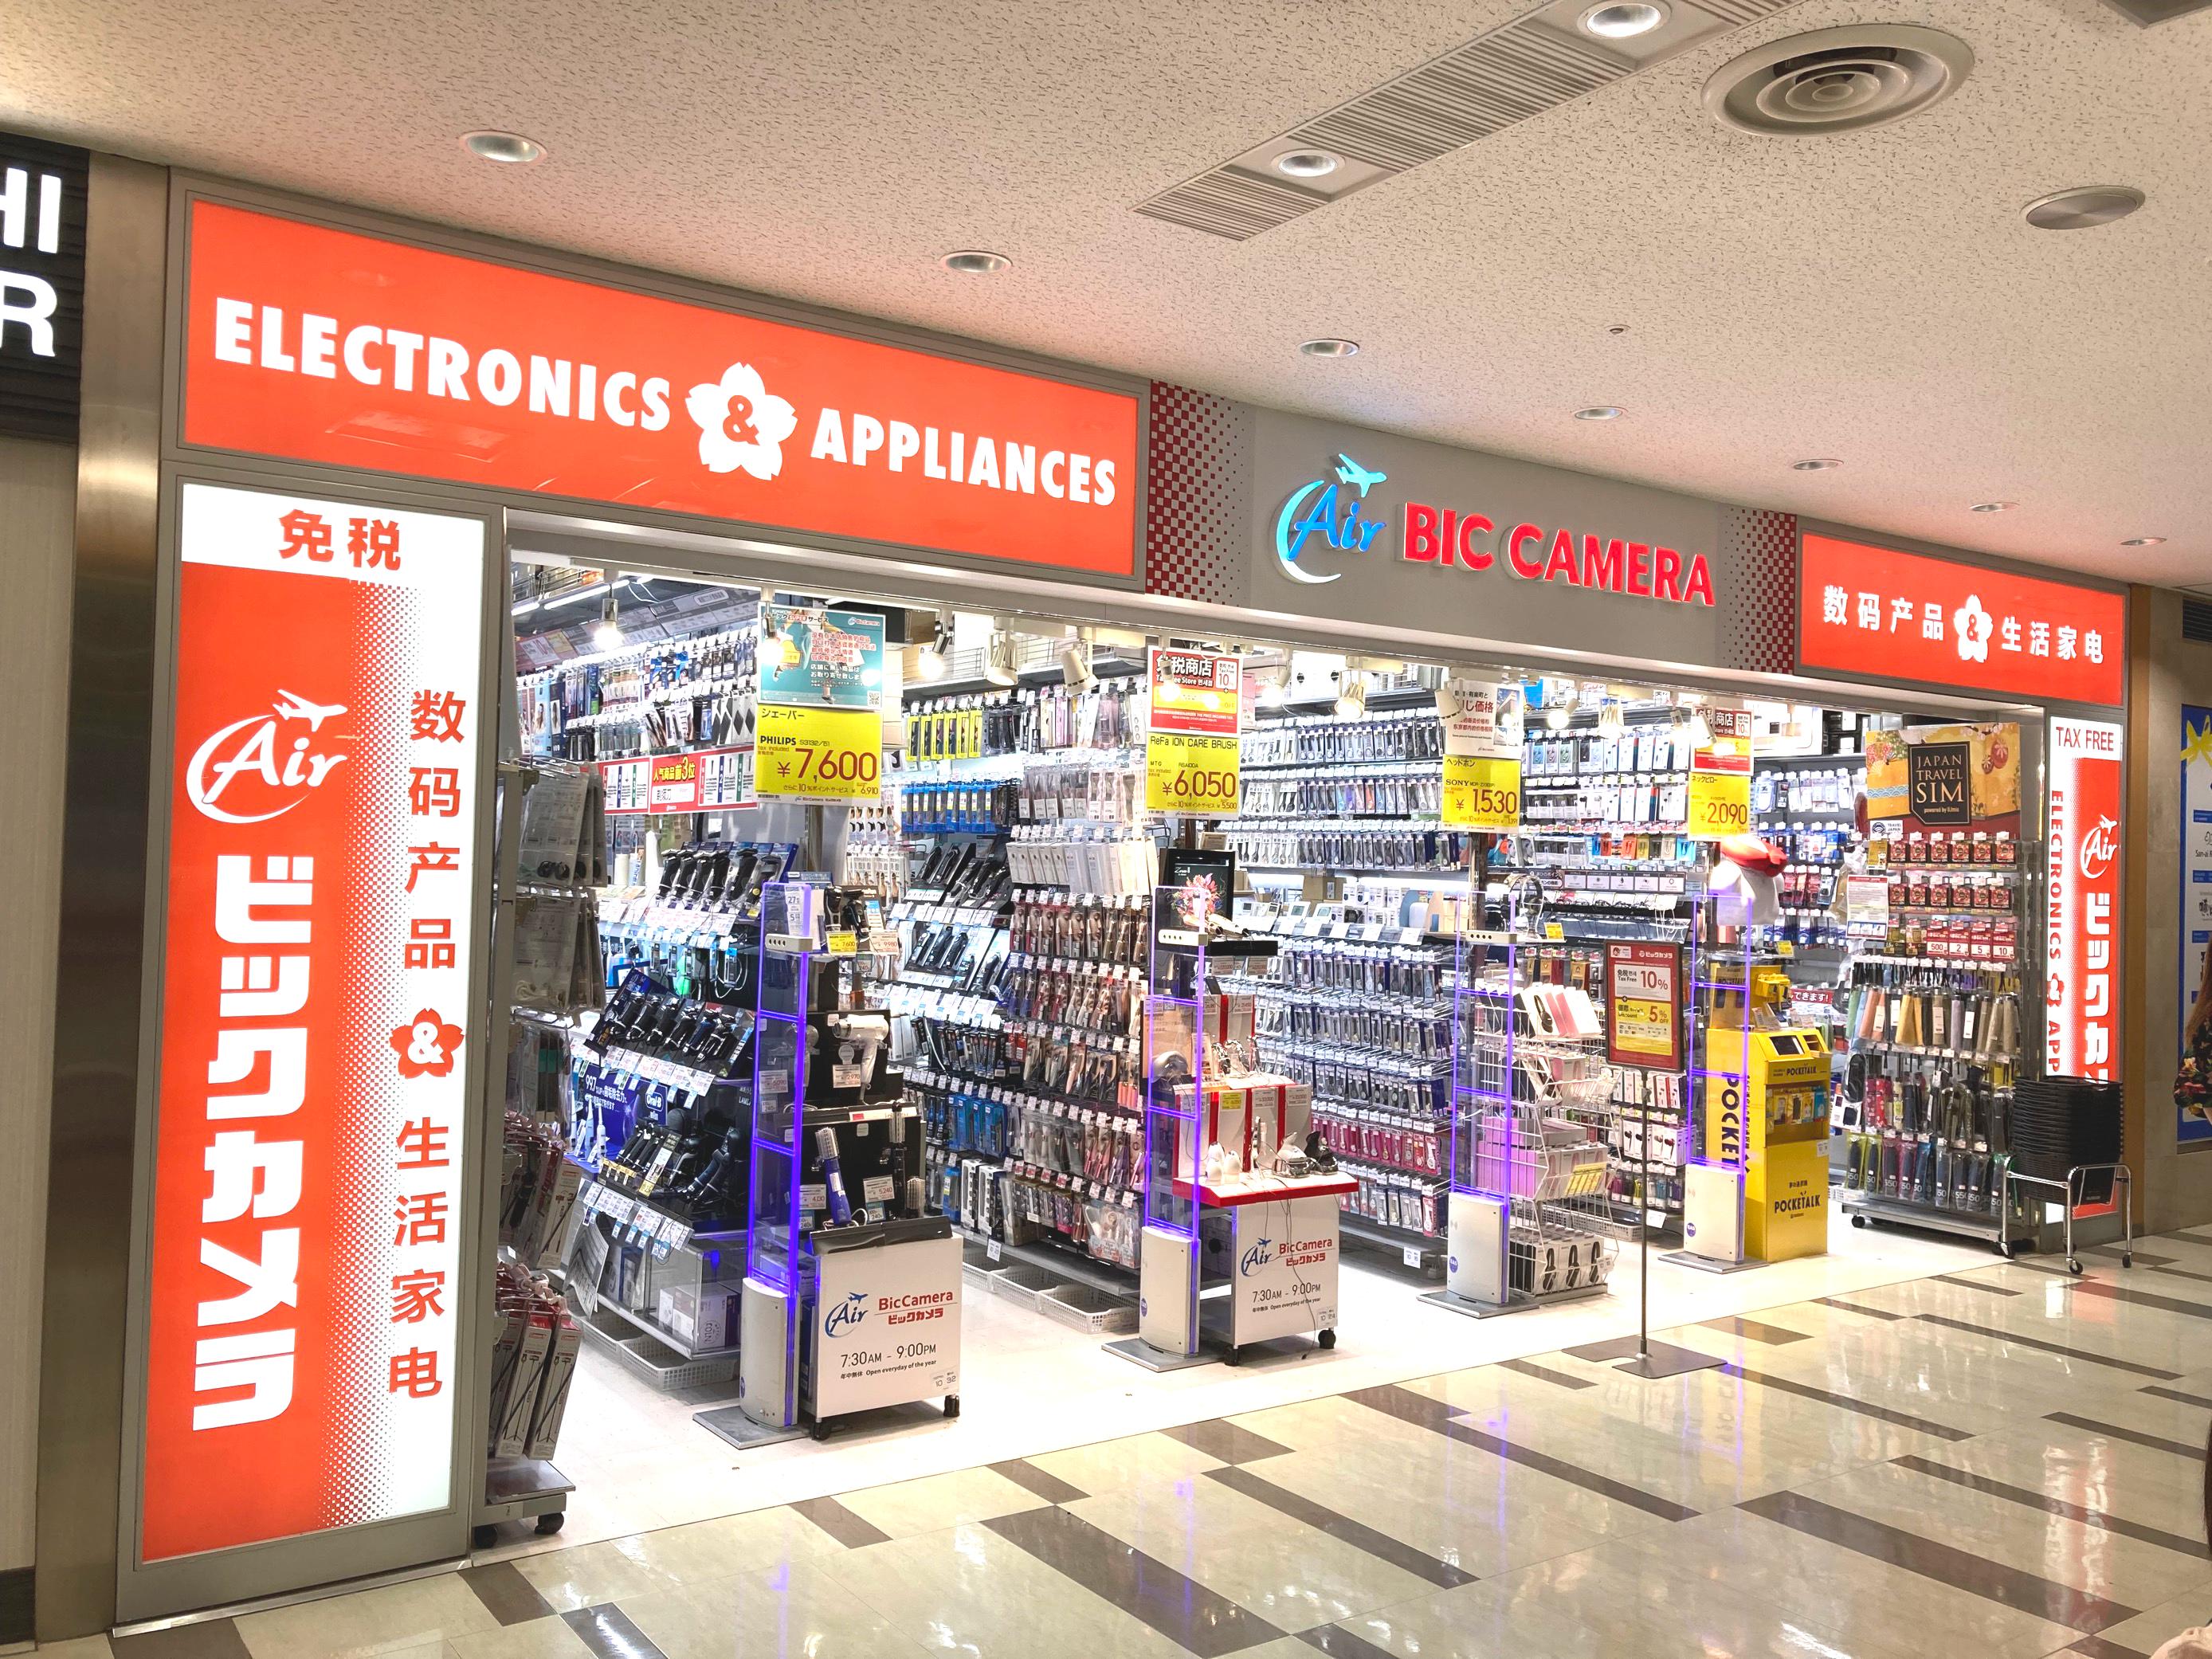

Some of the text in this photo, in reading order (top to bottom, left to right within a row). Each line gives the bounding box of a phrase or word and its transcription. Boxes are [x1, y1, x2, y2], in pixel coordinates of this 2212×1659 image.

[214, 296, 1115, 506] ELECTRONICS & APPLIANCES
[278, 508, 402, 571] 免税
[1288, 483, 1716, 607] Air BIC CAMERA
[1823, 586, 2104, 665] 数码产品 & 生活家电
[810, 671, 861, 680] お取り寄せ致しま
[761, 708, 805, 720] シェーバー
[1462, 699, 1494, 713] じ価格
[760, 735, 796, 746] PHILIPS
[1150, 735, 1237, 749] ReFa ION CARE BRUSH
[2056, 726, 2114, 751] TAX FREE
[202, 720, 348, 805] Air
[1916, 754, 1962, 769] JAPAN
[1916, 768, 1963, 781] TRAVEL
[861, 786, 879, 795] 6,910
[1916, 782, 1964, 804] SIM
[2085, 829, 2117, 871] Air
[2049, 790, 2063, 960] ELECTRONICS
[1956, 943, 1961, 952] 2
[1977, 945, 1983, 954] 5
[1998, 947, 2008, 955] 10
[389, 689, 466, 1399] 数码产品 & 生活家电
[1786, 1066, 1817, 1077] POCKETALK
[193, 855, 314, 1431] ビックカメラ
[1775, 1194, 1820, 1214] POCKETALK
[1279, 1238, 1332, 1254] BicCamera
[1245, 1247, 1273, 1273] Air
[1286, 1253, 1326, 1267] ビックカメラ
[879, 1291, 953, 1311] BicCamera
[1252, 1288, 1282, 1303] 7:30AM
[1292, 1282, 1321, 1296] 9:00PM
[1281, 1300, 1300, 1309] everyday
[830, 1303, 869, 1333] Air
[888, 1308, 944, 1325] ビックカメラ
[841, 1352, 882, 1368] 7:30AM
[896, 1343, 936, 1359] 9:00PM
[865, 1368, 881, 1377] Open
[881, 1364, 908, 1374] everyday
